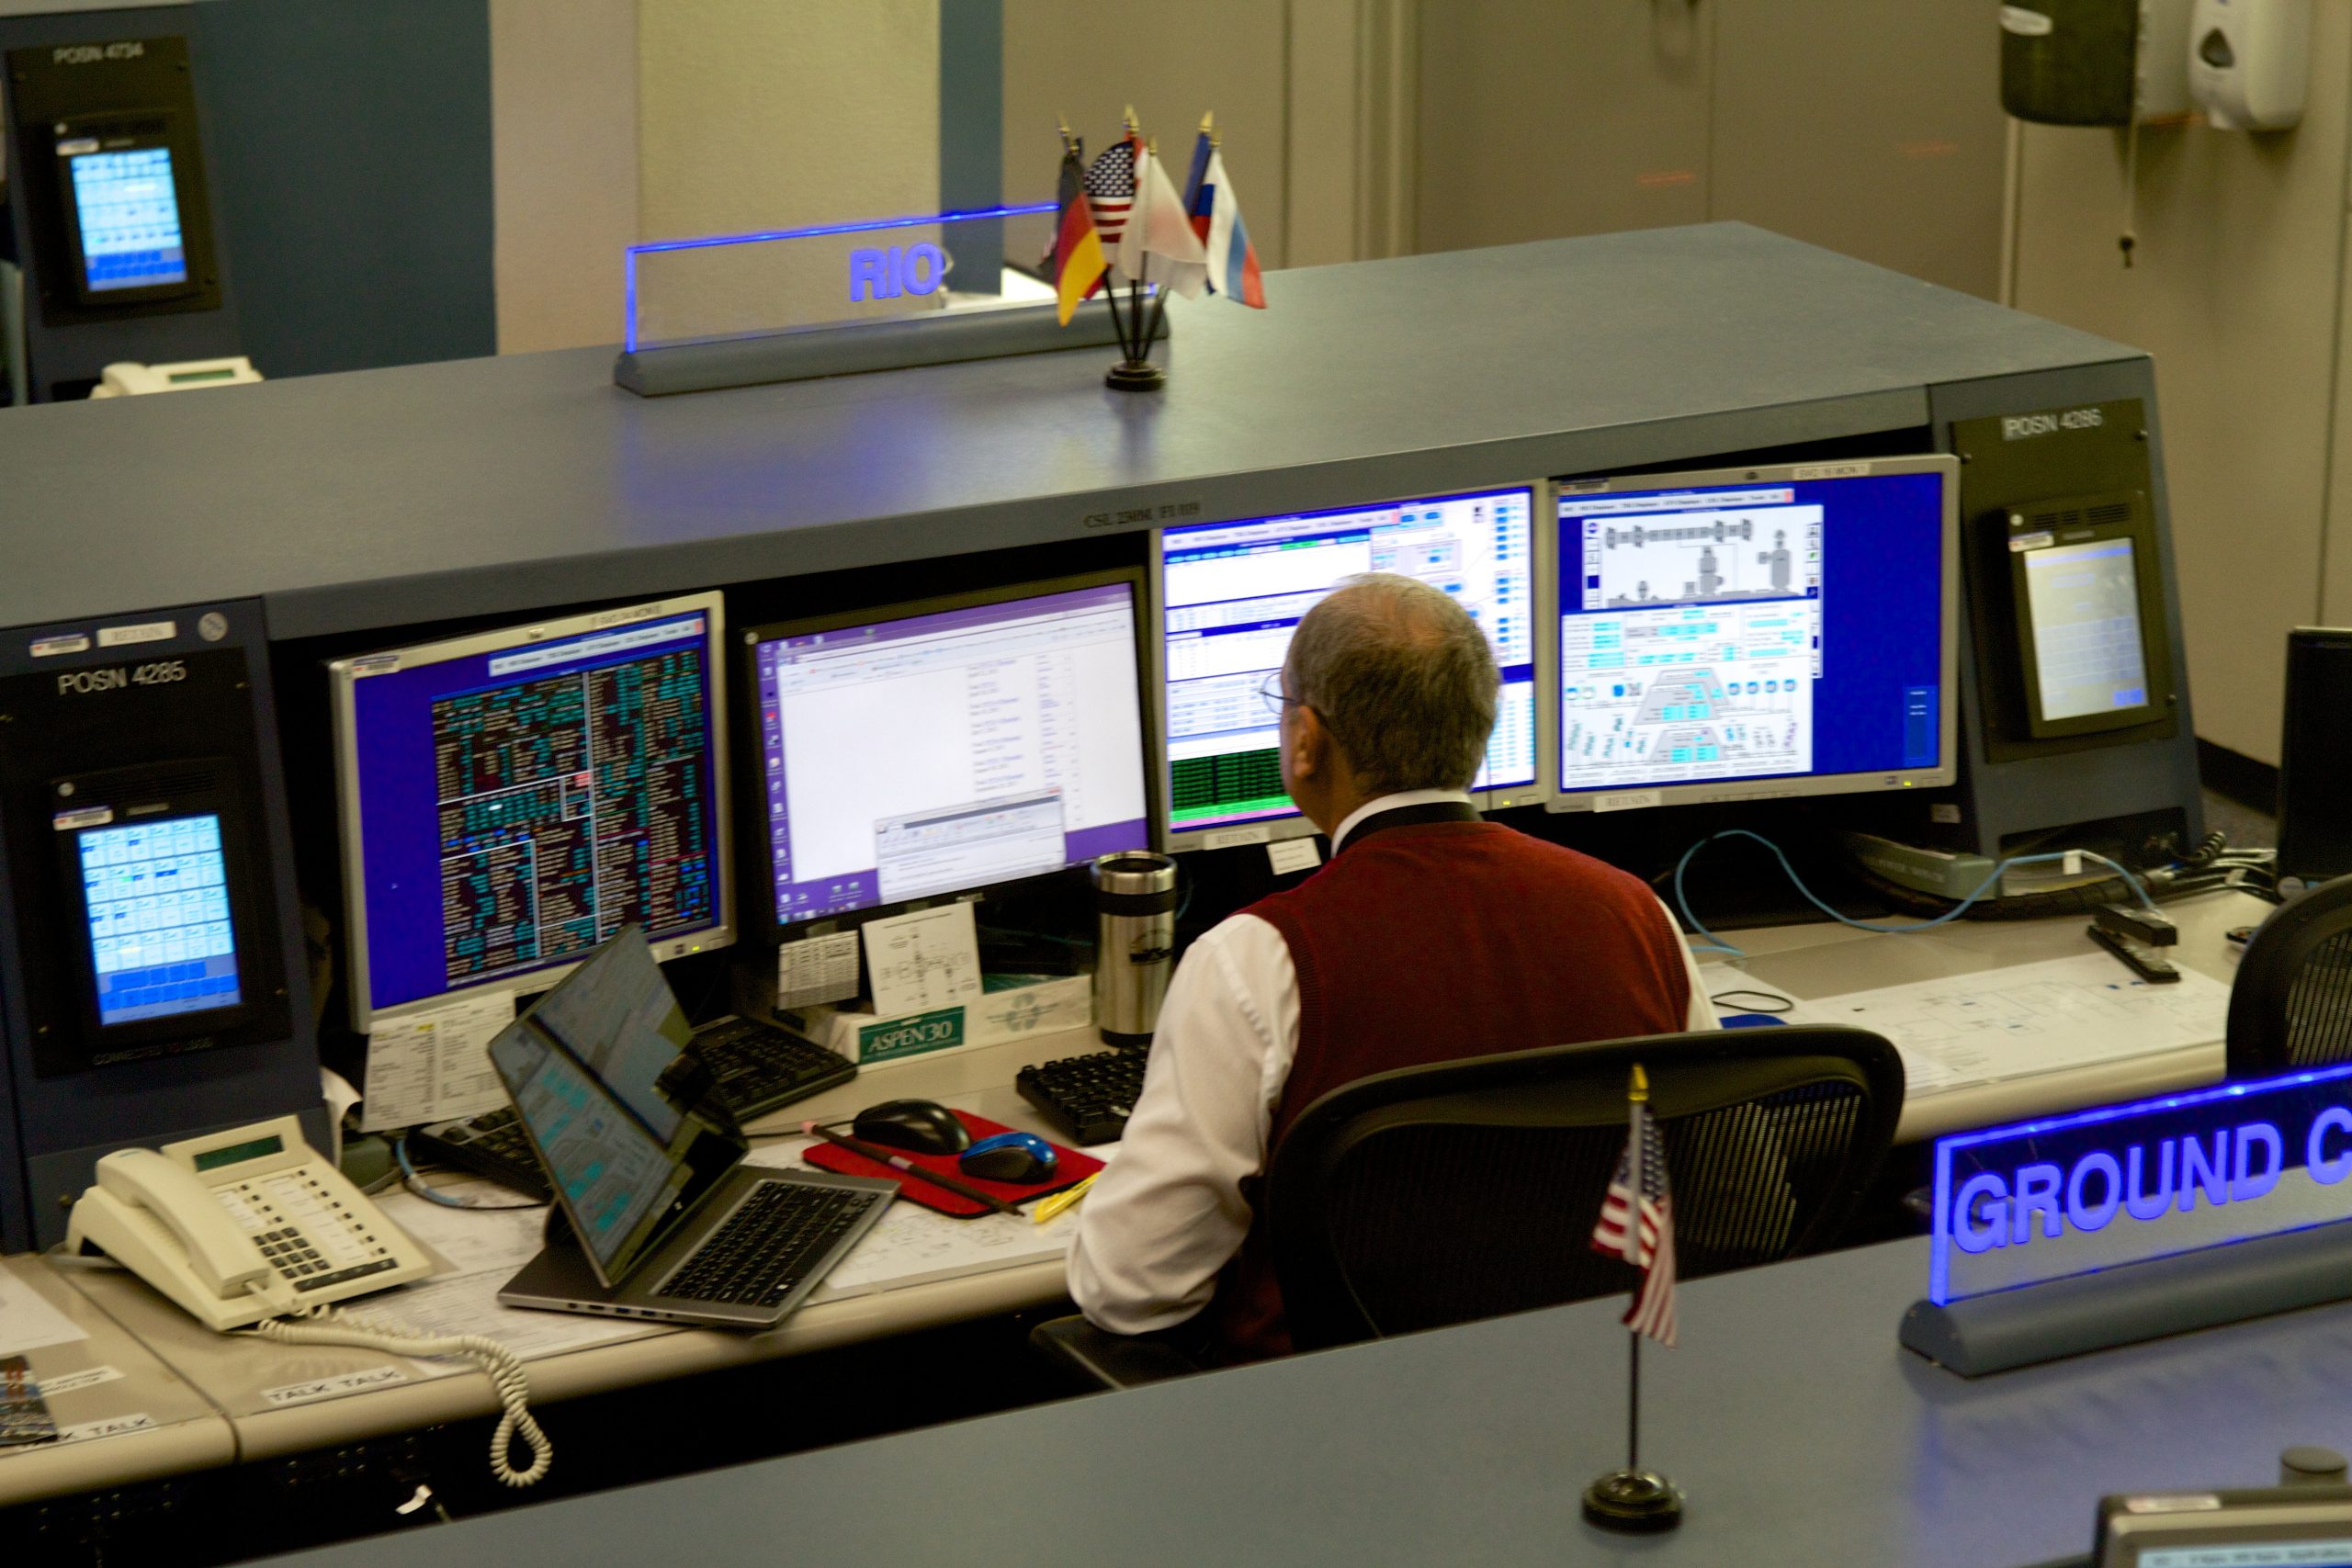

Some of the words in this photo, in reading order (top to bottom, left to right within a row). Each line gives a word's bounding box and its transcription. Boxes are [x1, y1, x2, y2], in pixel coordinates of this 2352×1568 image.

[52, 46, 103, 64] POSN
[850, 243, 944, 301] RIO
[2003, 415, 2058, 438] POSN
[57, 667, 128, 695] POSN
[131, 660, 187, 686] 4285
[867, 1024, 926, 1053] ASPEN
[927, 1021, 954, 1042] 30
[1954, 1123, 2283, 1253] GROUND
[268, 1383, 331, 1402] TALK
[338, 1371, 401, 1388] TALK
[87, 1417, 152, 1438] TALK
